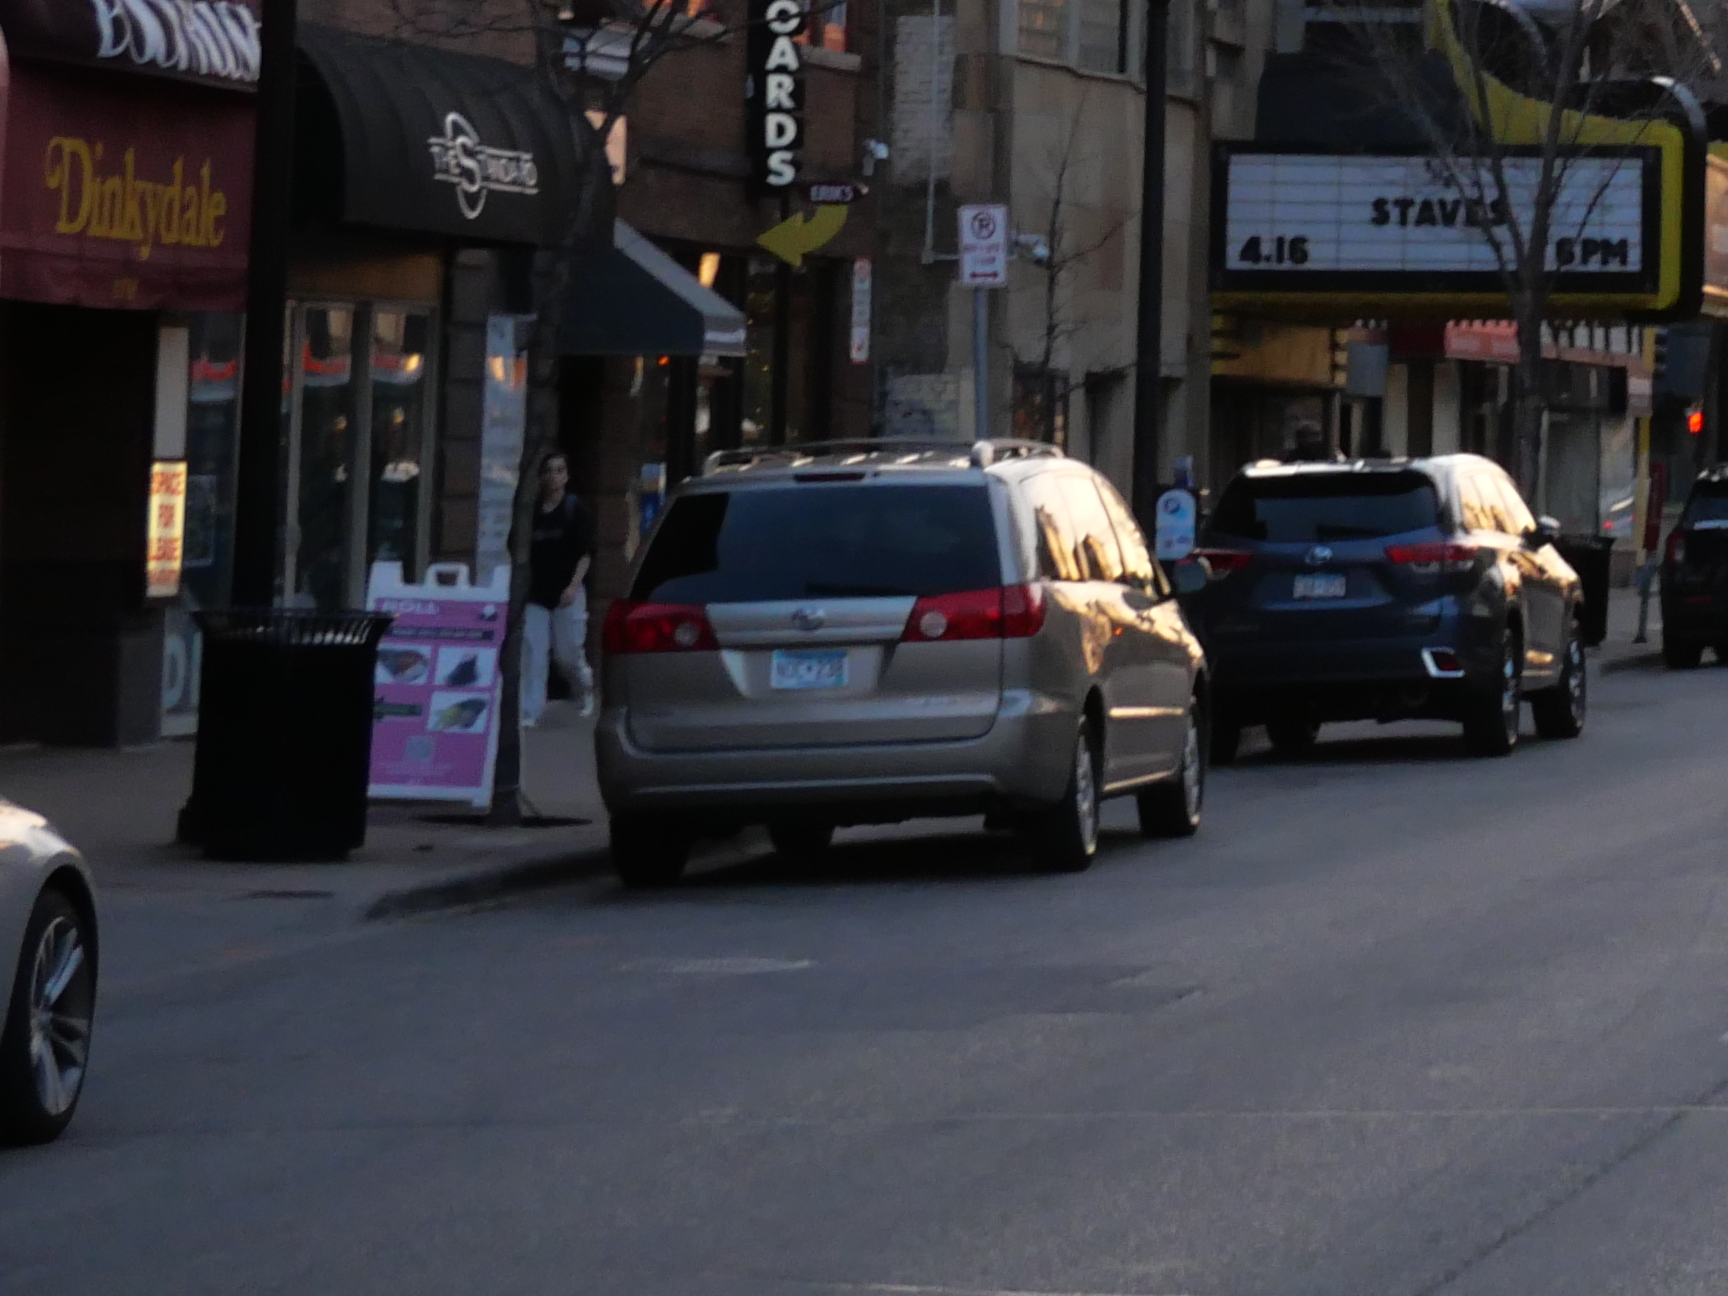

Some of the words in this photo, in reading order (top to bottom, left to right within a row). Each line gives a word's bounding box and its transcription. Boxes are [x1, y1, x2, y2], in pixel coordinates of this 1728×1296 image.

[45, 135, 227, 259] Dinkydale
[1370, 197, 1511, 226] STAVES
[1239, 236, 1310, 266] 4.16
